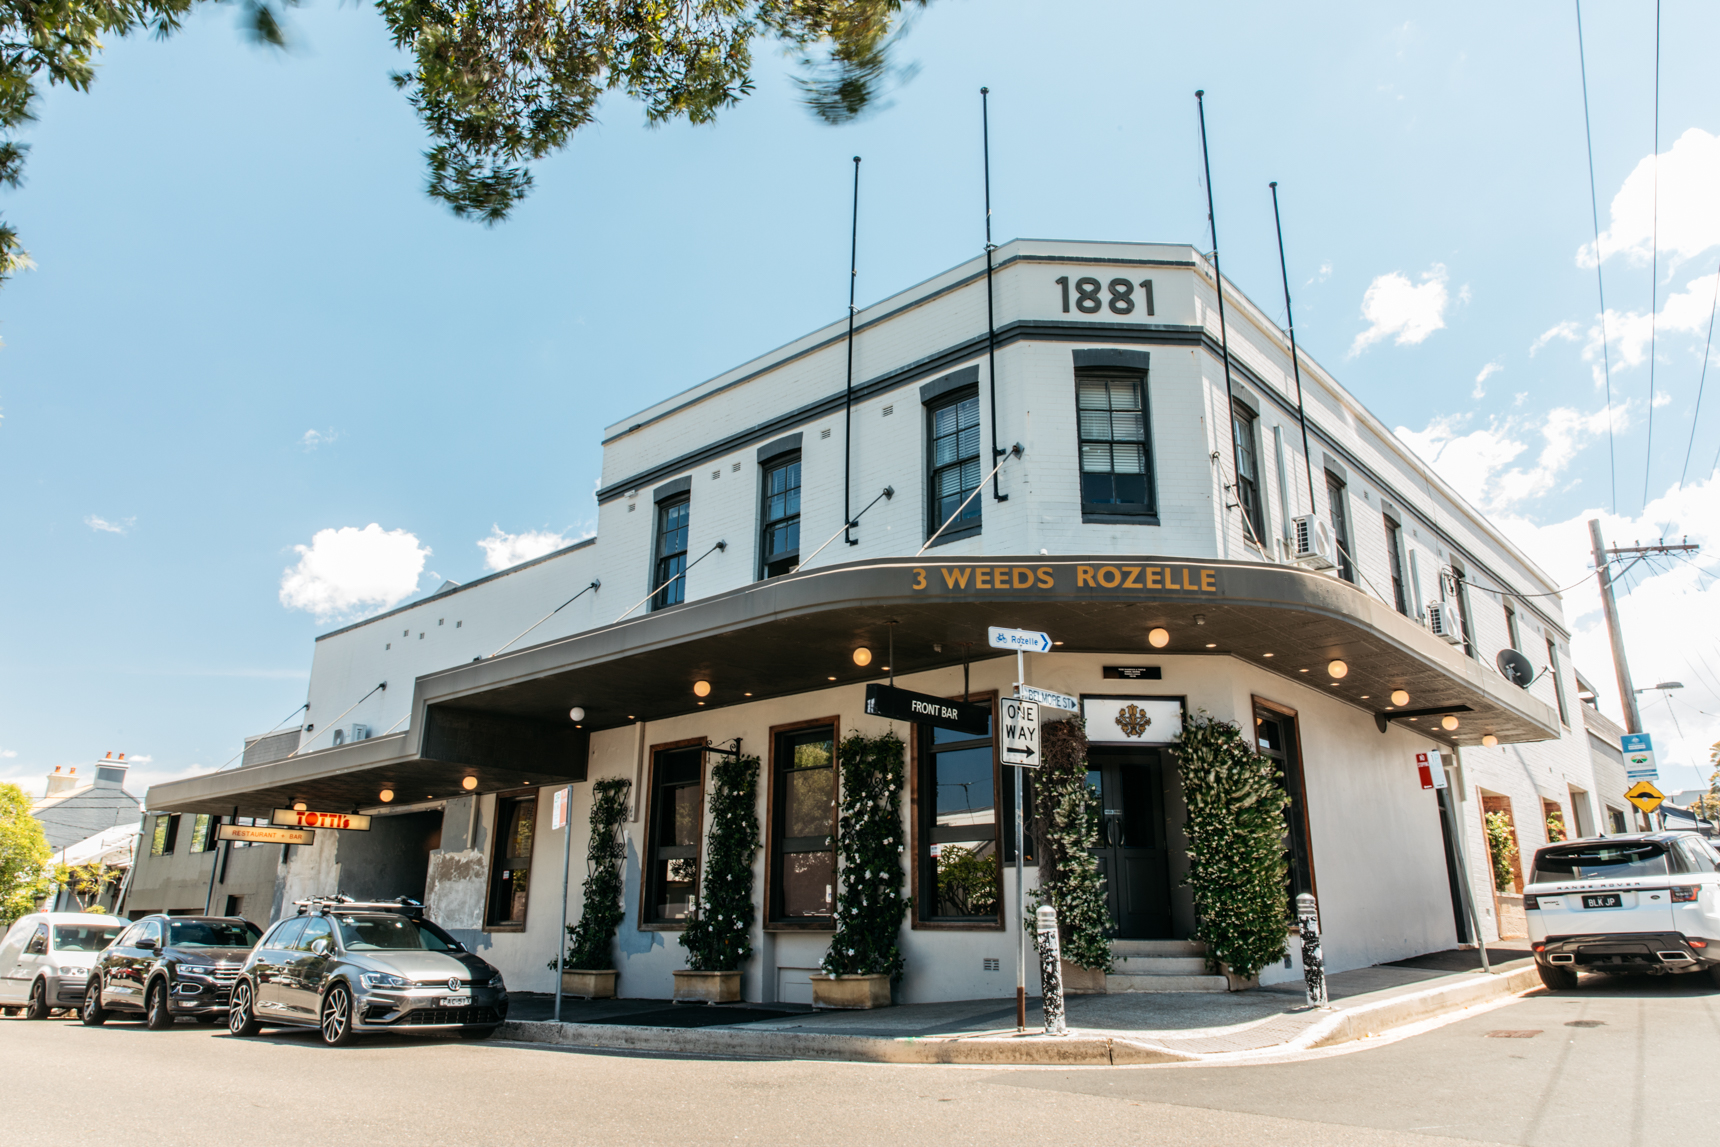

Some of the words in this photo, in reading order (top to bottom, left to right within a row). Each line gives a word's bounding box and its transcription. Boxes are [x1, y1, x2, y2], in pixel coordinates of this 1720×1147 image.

[1055, 276, 1156, 316] 1881
[912, 568, 927, 590] 3
[941, 566, 1054, 590] WEEDS
[1076, 565, 1217, 592] ROZELLE
[1011, 635, 1039, 646] Rozelle
[1028, 689, 1061, 707] BELMORE
[1063, 697, 1071, 709] ST
[911, 700, 940, 716] FRONT
[941, 706, 958, 720] BAR
[1007, 704, 1034, 721] ONE
[1006, 724, 1036, 742] WAY
[232, 830, 277, 838] RESTAURANT
[1588, 898, 1604, 907] BLK
[1605, 897, 1615, 906] JP
